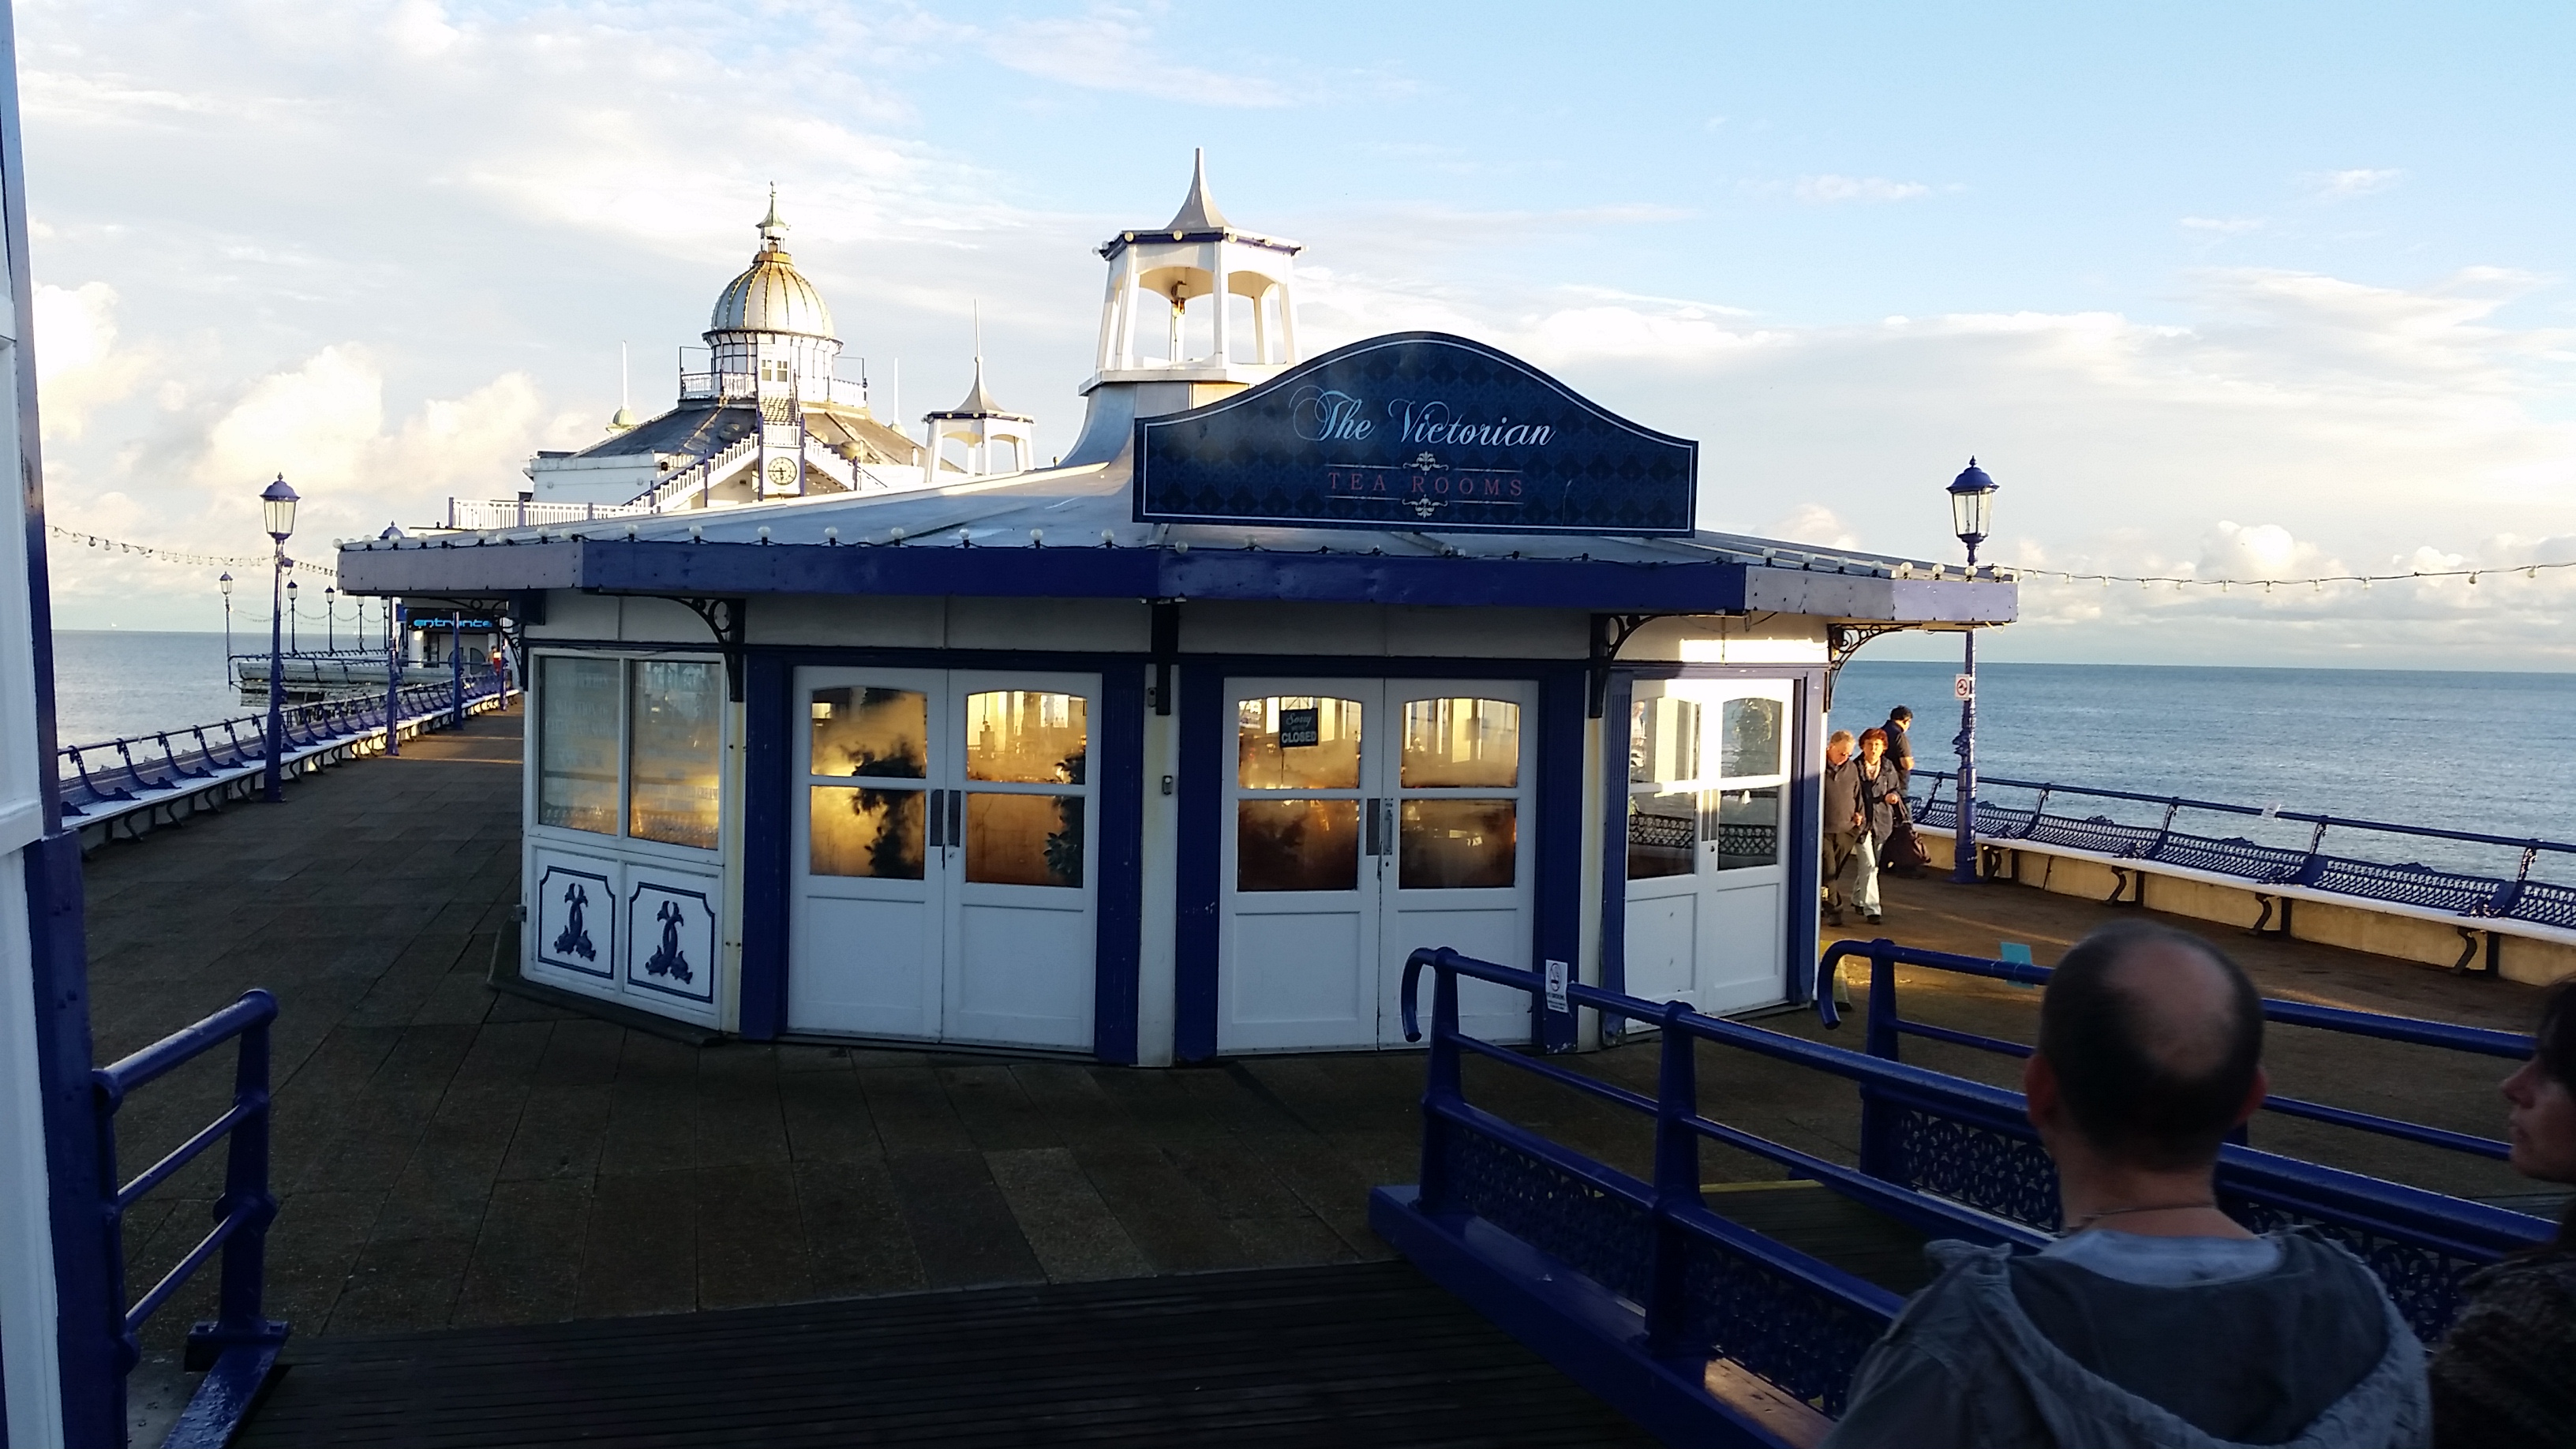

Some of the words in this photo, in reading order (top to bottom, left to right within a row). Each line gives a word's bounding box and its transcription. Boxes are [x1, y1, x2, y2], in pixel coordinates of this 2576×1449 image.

[1289, 385, 1376, 441] The
[1387, 398, 1556, 447] Victorian
[1328, 472, 1387, 492] TEA
[1411, 475, 1522, 496] ROOMS
[1282, 732, 1316, 743] CLOSED
